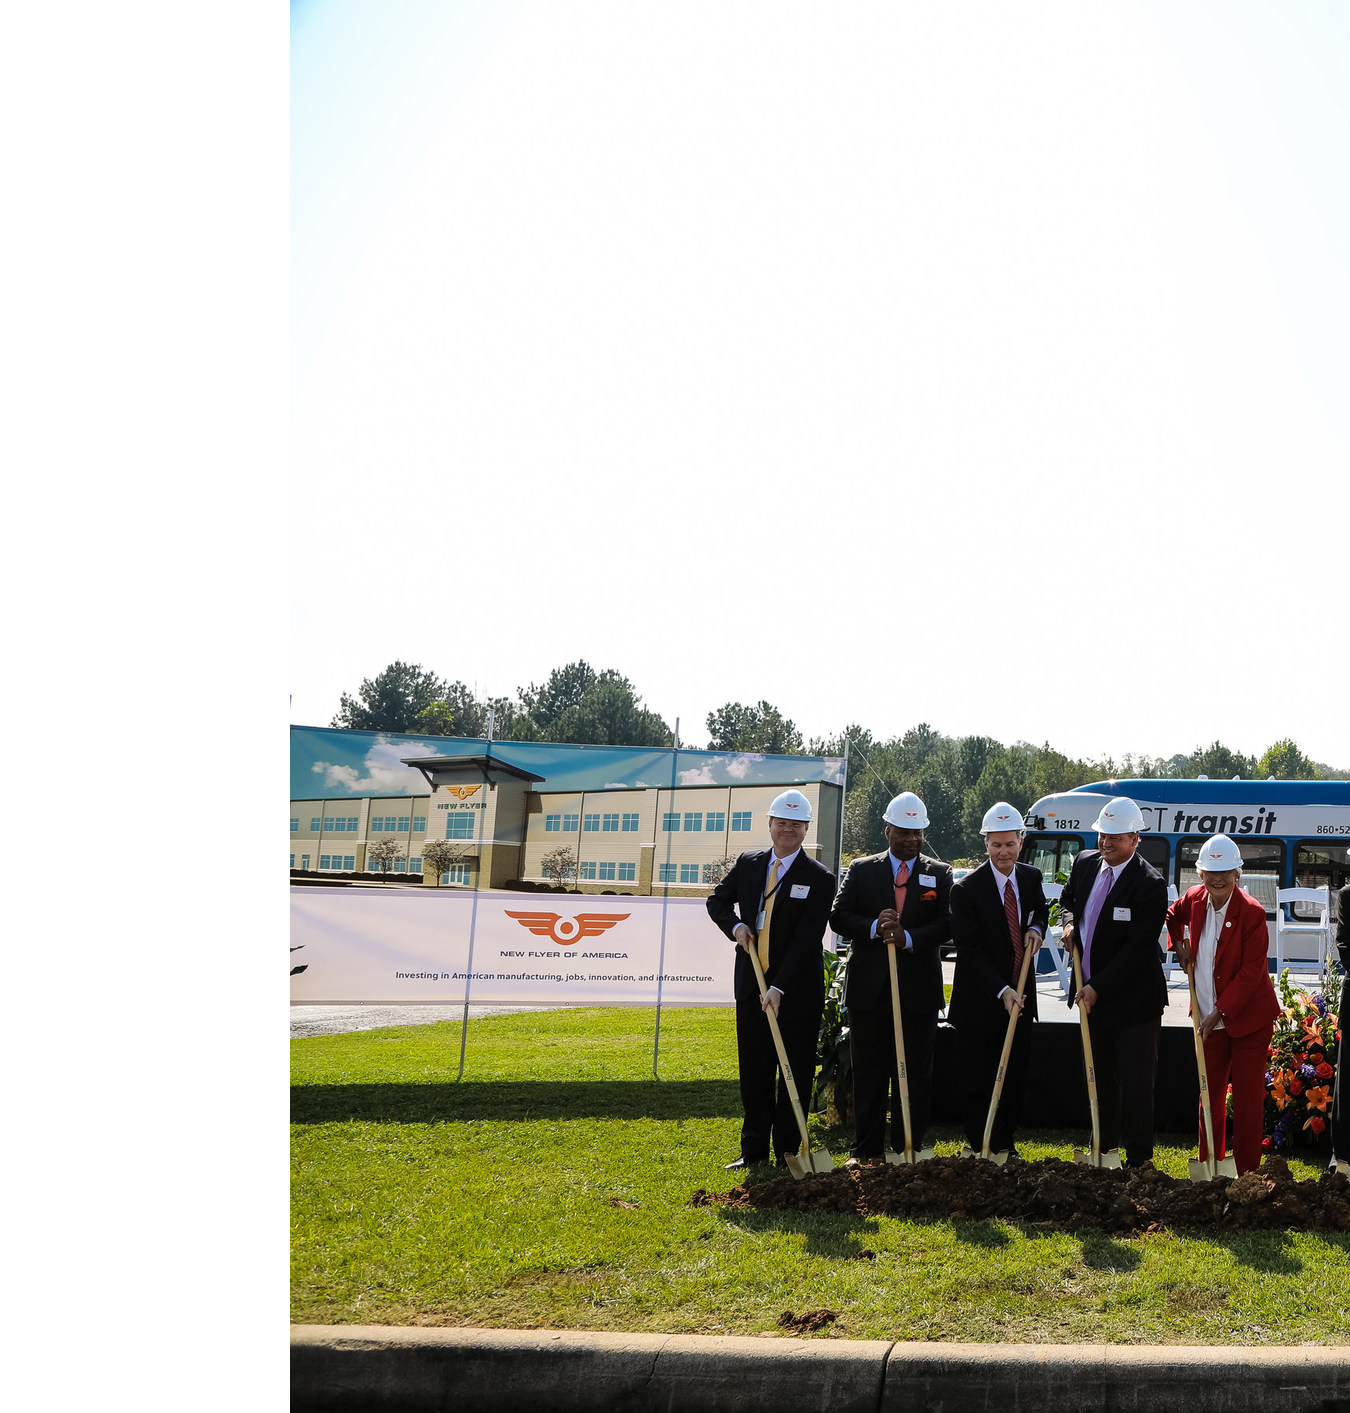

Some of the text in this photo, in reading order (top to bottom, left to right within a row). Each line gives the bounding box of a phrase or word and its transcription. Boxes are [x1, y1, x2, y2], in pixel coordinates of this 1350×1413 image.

[1054, 819, 1080, 830] 1812
[1173, 806, 1277, 833] transit
[396, 972, 438, 981] Investing
[452, 972, 494, 980] American
[496, 972, 564, 982] manufacturing,
[565, 973, 586, 982] jobs,
[588, 974, 636, 982] innovation,
[656, 974, 714, 982] infrastructure.
